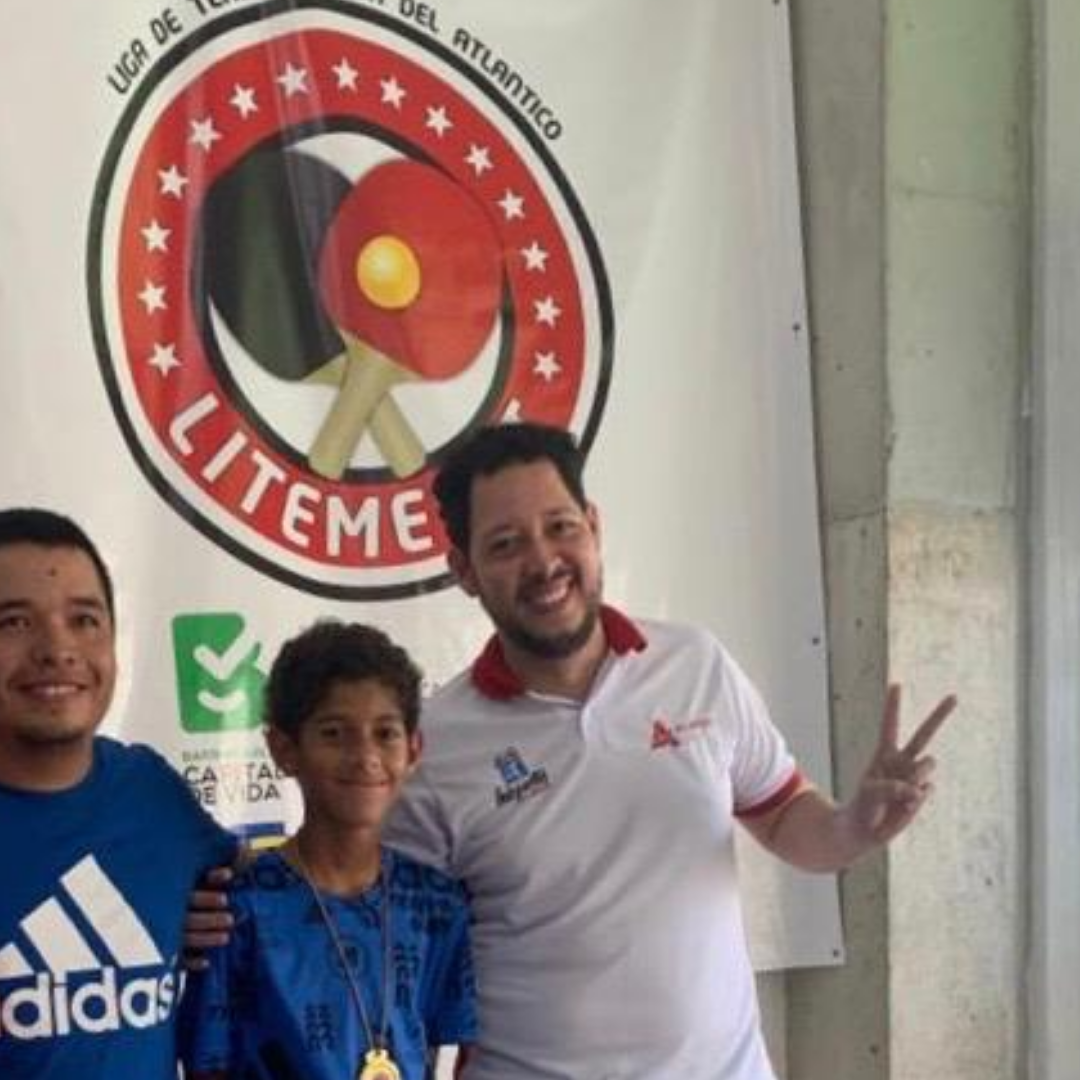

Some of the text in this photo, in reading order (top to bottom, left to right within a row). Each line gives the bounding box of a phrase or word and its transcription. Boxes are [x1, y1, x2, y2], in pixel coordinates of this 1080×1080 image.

[107, 9, 183, 95] LIGA DE
[399, 0, 562, 140] DEL ATLANTICO
[169, 393, 433, 558] LITEME
